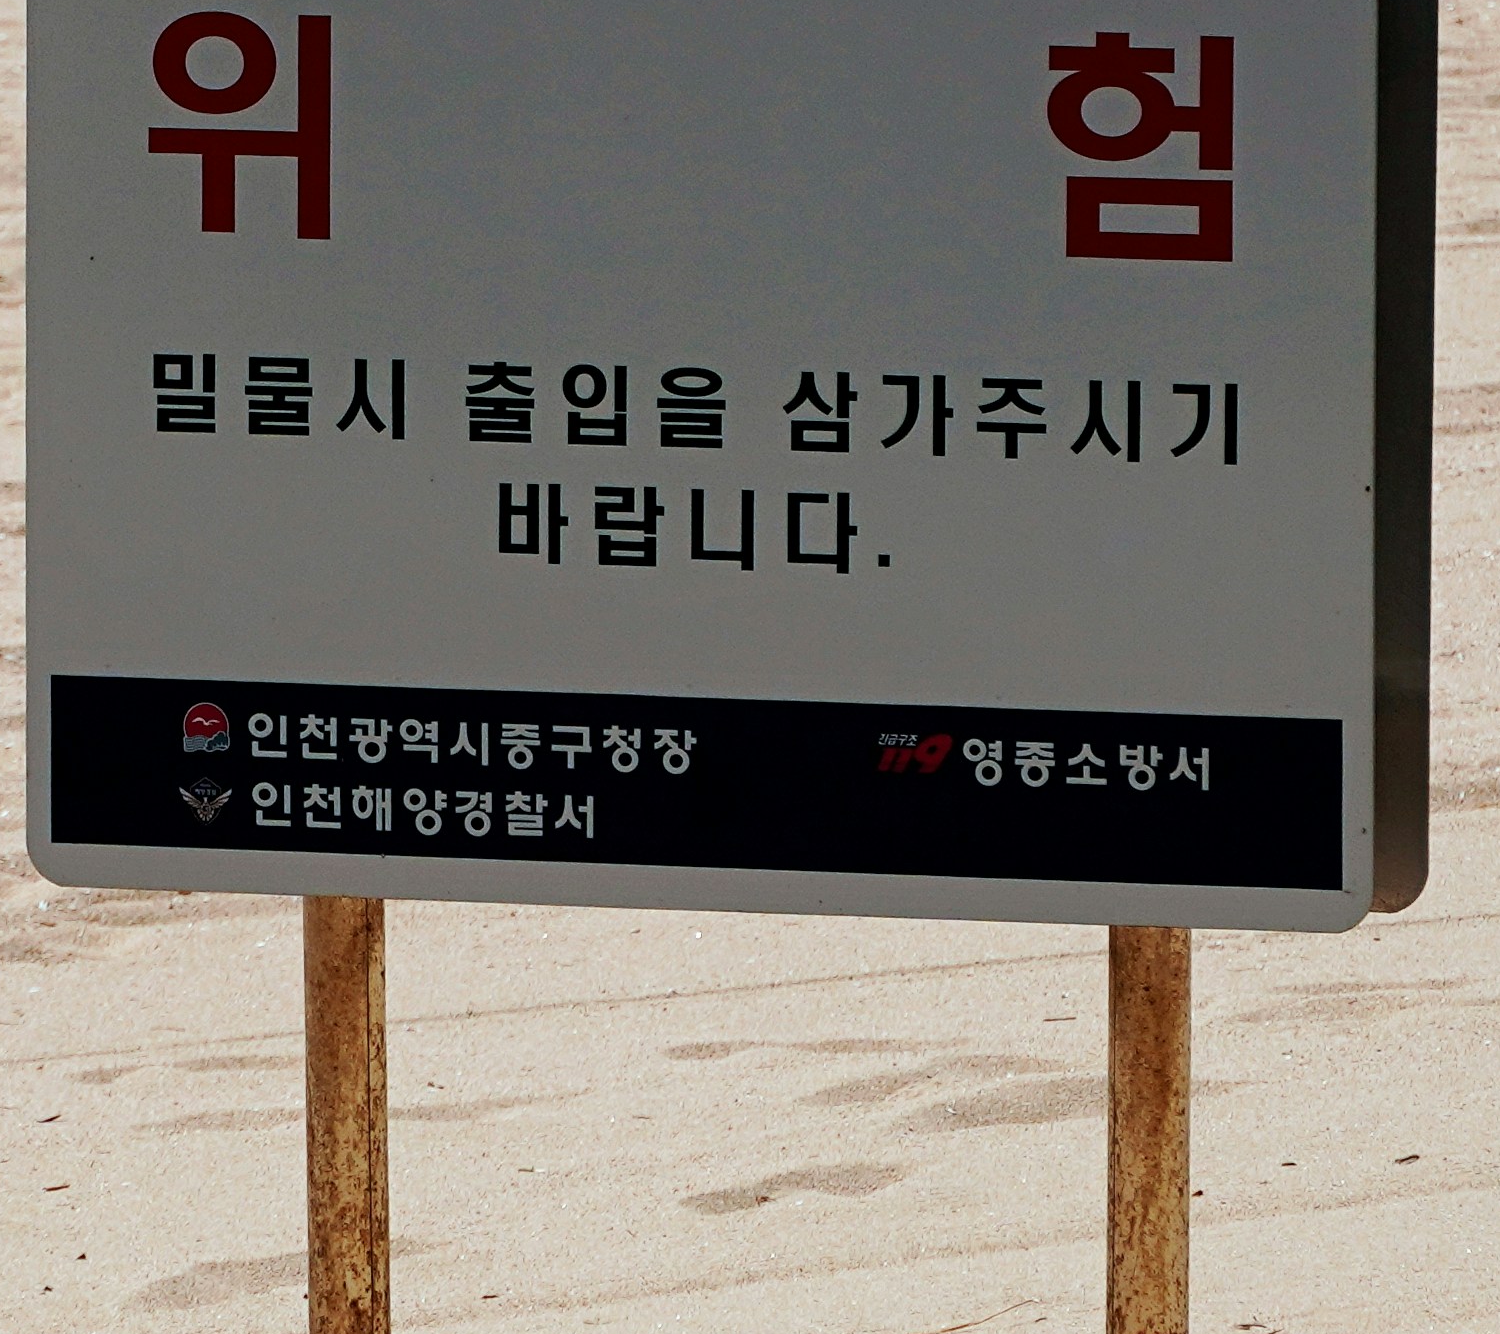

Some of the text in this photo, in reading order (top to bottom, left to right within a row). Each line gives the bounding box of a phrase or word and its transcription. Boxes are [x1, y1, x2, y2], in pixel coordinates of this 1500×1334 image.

[148, 11, 1234, 263] 위 험
[152, 352, 1240, 467] 밀물시 출입을 삼가주시기
[498, 481, 893, 575] 바랍니다.
[247, 711, 698, 776] 인천광역시중구청장
[878, 733, 953, 774] 119
[962, 737, 1211, 792] 영종소방서
[251, 780, 595, 840] 인천해양경찰서
